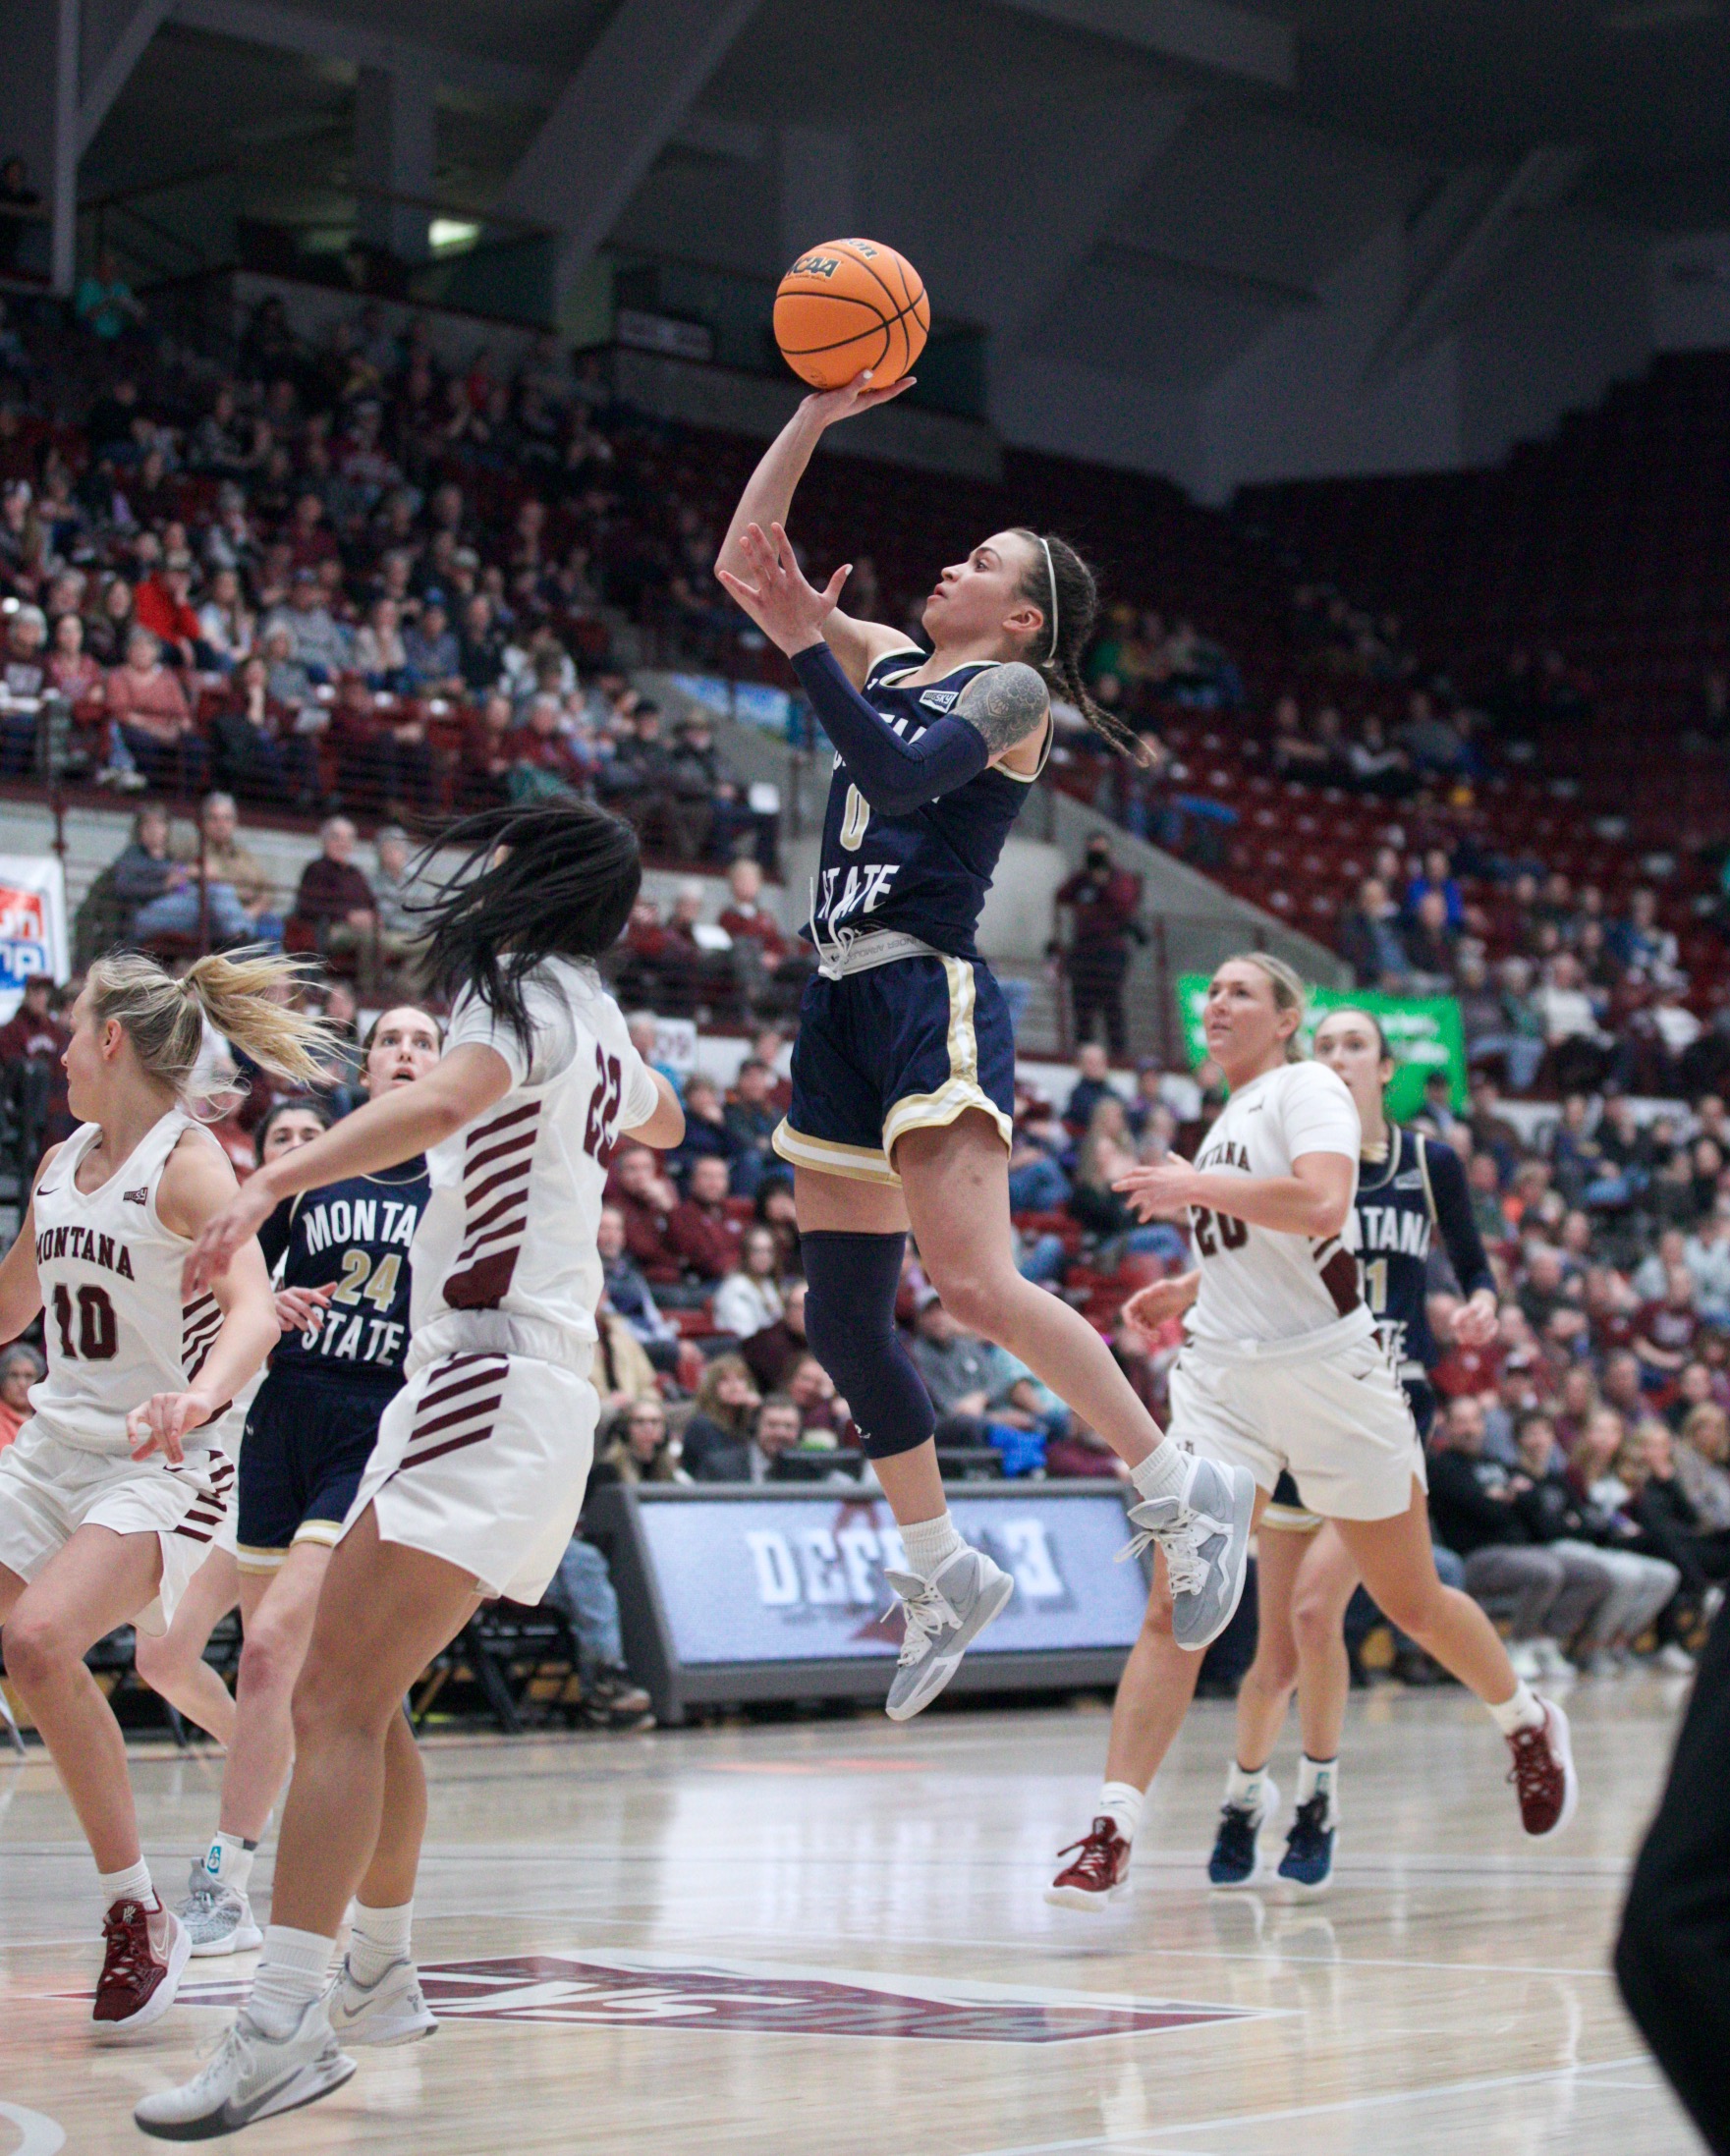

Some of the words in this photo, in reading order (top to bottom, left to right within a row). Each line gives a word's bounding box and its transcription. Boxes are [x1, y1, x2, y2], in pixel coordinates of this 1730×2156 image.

[840, 783, 870, 852] 0
[302, 1199, 419, 1255] MONTA
[1190, 1204, 1249, 1258] 20
[332, 1248, 402, 1313] 24
[52, 1283, 120, 1361] 10
[301, 1306, 405, 1367] STATE
